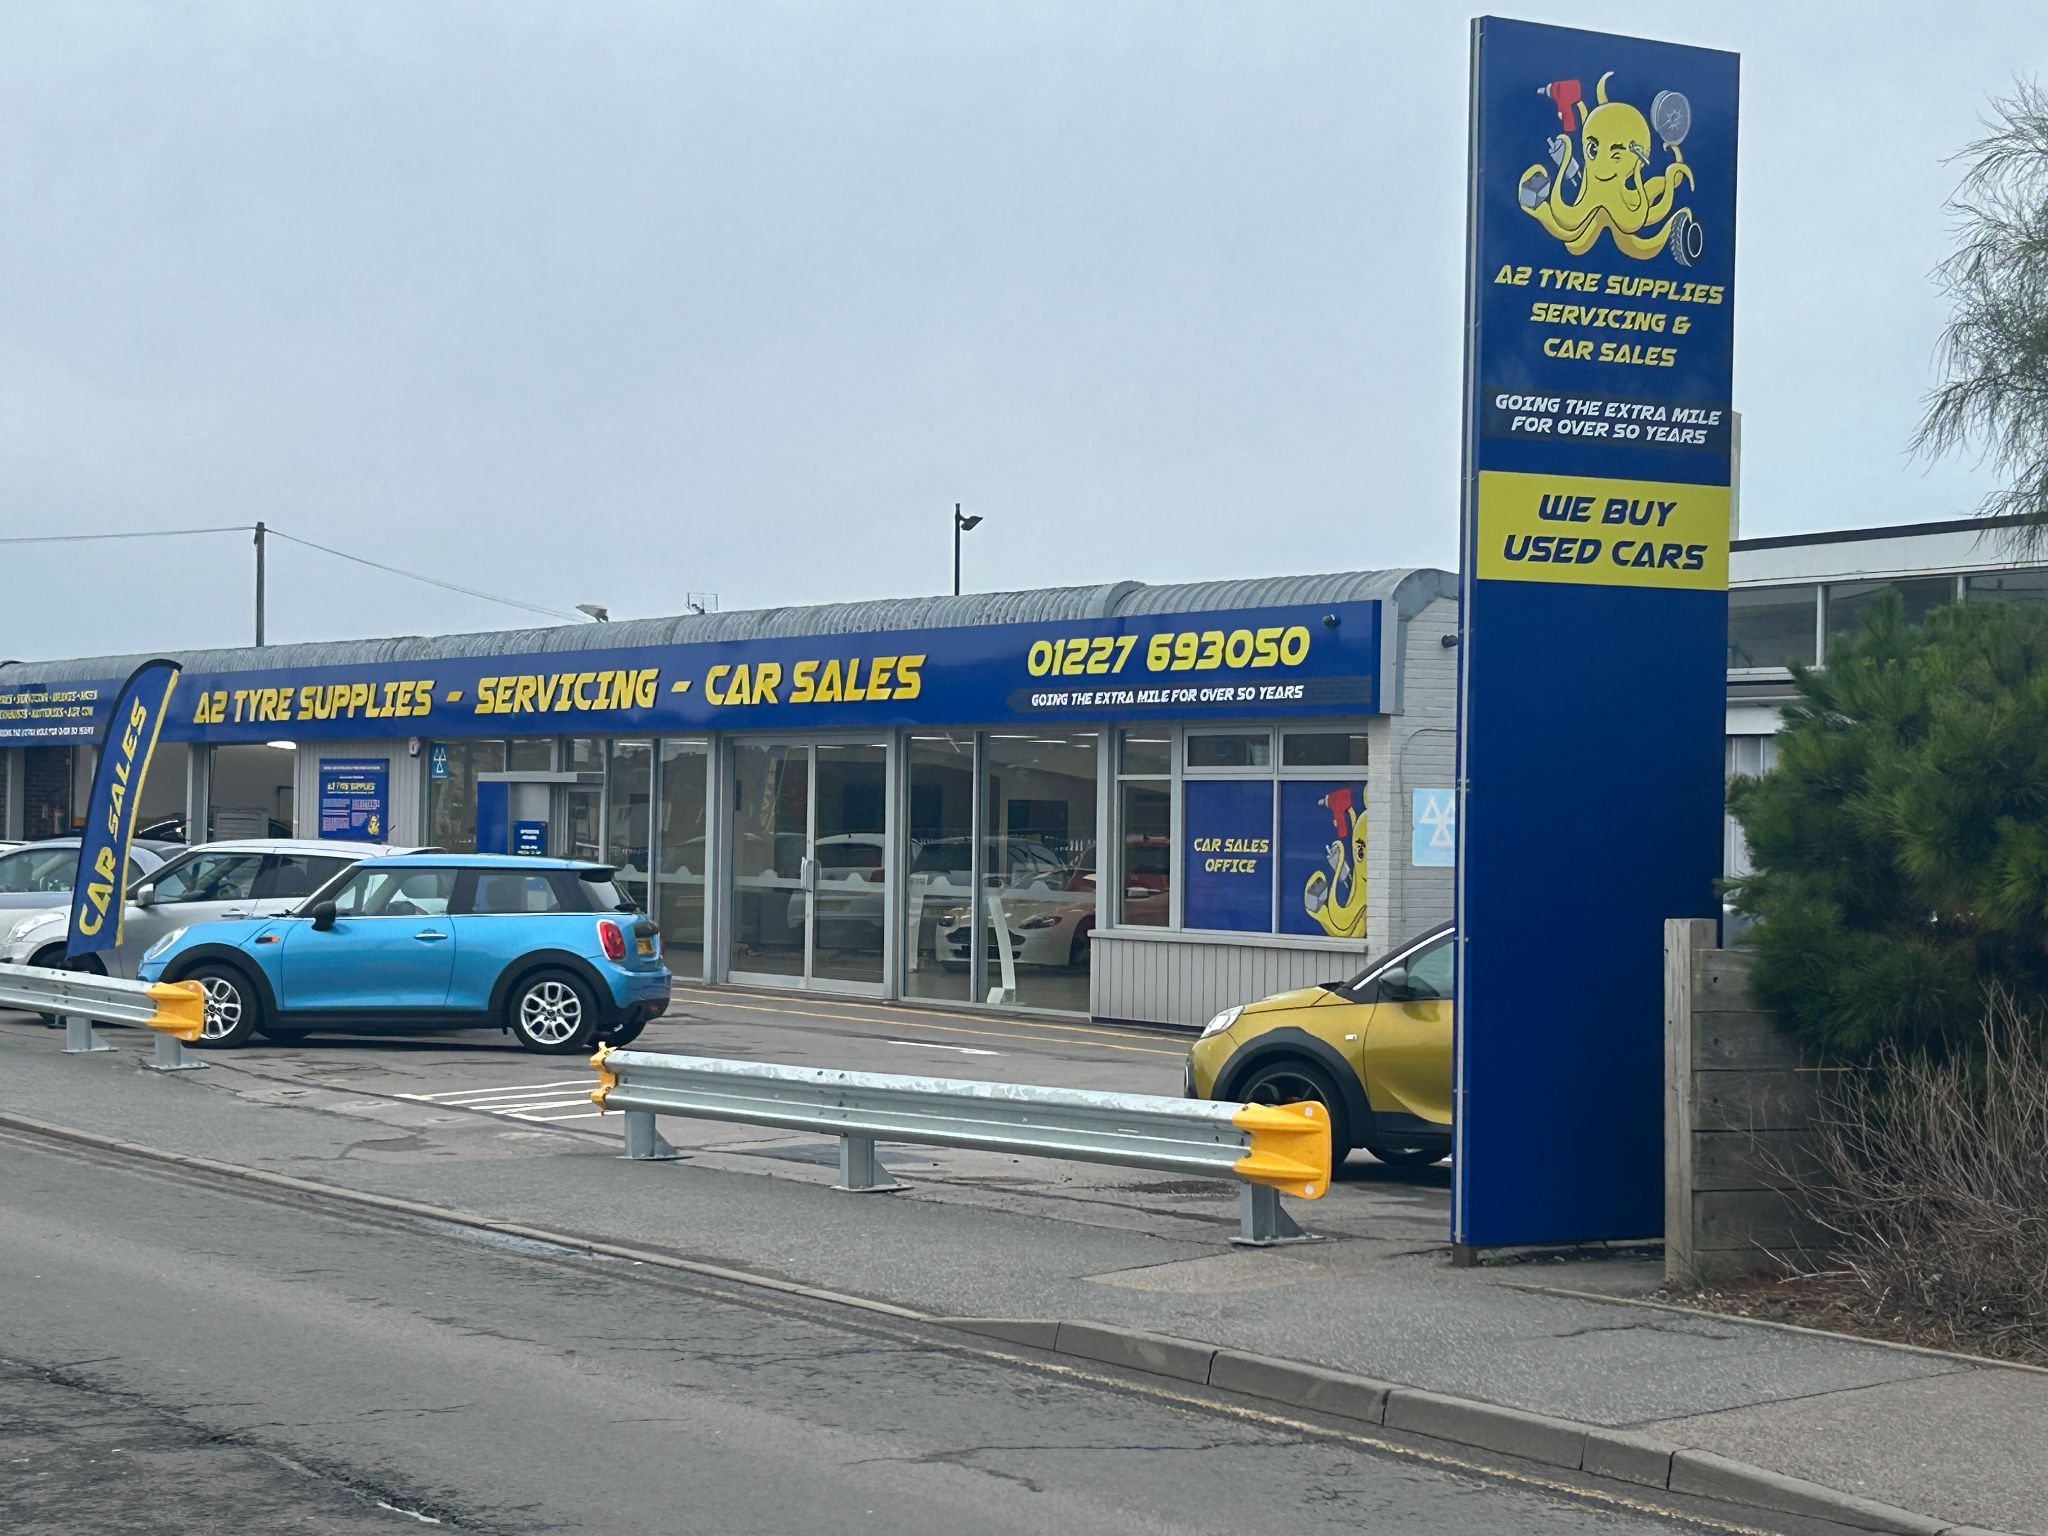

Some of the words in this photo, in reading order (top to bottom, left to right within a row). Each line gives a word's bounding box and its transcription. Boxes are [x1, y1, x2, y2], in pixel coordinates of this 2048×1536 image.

[1494, 265, 1533, 286] A2
[1539, 268, 1602, 292] TYRE
[1605, 275, 1725, 305] SUPPLIES
[1530, 303, 1666, 334] SERVICING
[1672, 316, 1691, 335] &
[1543, 338, 1592, 361] CAR
[1598, 343, 1677, 368] SALES
[1495, 394, 1561, 413] GOING
[1566, 399, 1602, 417] THE
[1604, 403, 1666, 422] EXTRA
[1672, 408, 1721, 426] MILE
[1511, 416, 1553, 434] FOR
[1557, 419, 1608, 438] OVER
[1612, 424, 1640, 440] 50
[1646, 426, 1707, 445] YEARS
[1538, 494, 1596, 523] WE
[1601, 499, 1677, 527] BUY
[1503, 534, 1602, 564] USED
[1611, 541, 1708, 570] CARS
[1028, 635, 1138, 677] 01227
[1146, 626, 1311, 672] 693050
[194, 692, 229, 724] A2
[233, 687, 295, 722] TYRE
[297, 680, 436, 720] SUPPLIES
[476, 668, 660, 714] SERVICING
[704, 662, 783, 706] CAR
[788, 654, 927, 703] SALES
[1031, 693, 1068, 707] GOING
[1071, 692, 1093, 706] THE
[1095, 690, 1134, 705] EXTRA
[1137, 689, 1169, 703] MILE
[1171, 688, 1197, 702] FOR
[1200, 687, 1234, 702] OVER
[1236, 687, 1255, 701] 50
[1259, 685, 1305, 700] YEARS
[79, 847, 116, 937] CAR
[109, 697, 146, 842] SALES
[1194, 837, 1221, 852] CAR
[1224, 838, 1269, 853] SALES
[1205, 858, 1256, 873] OFFICE
